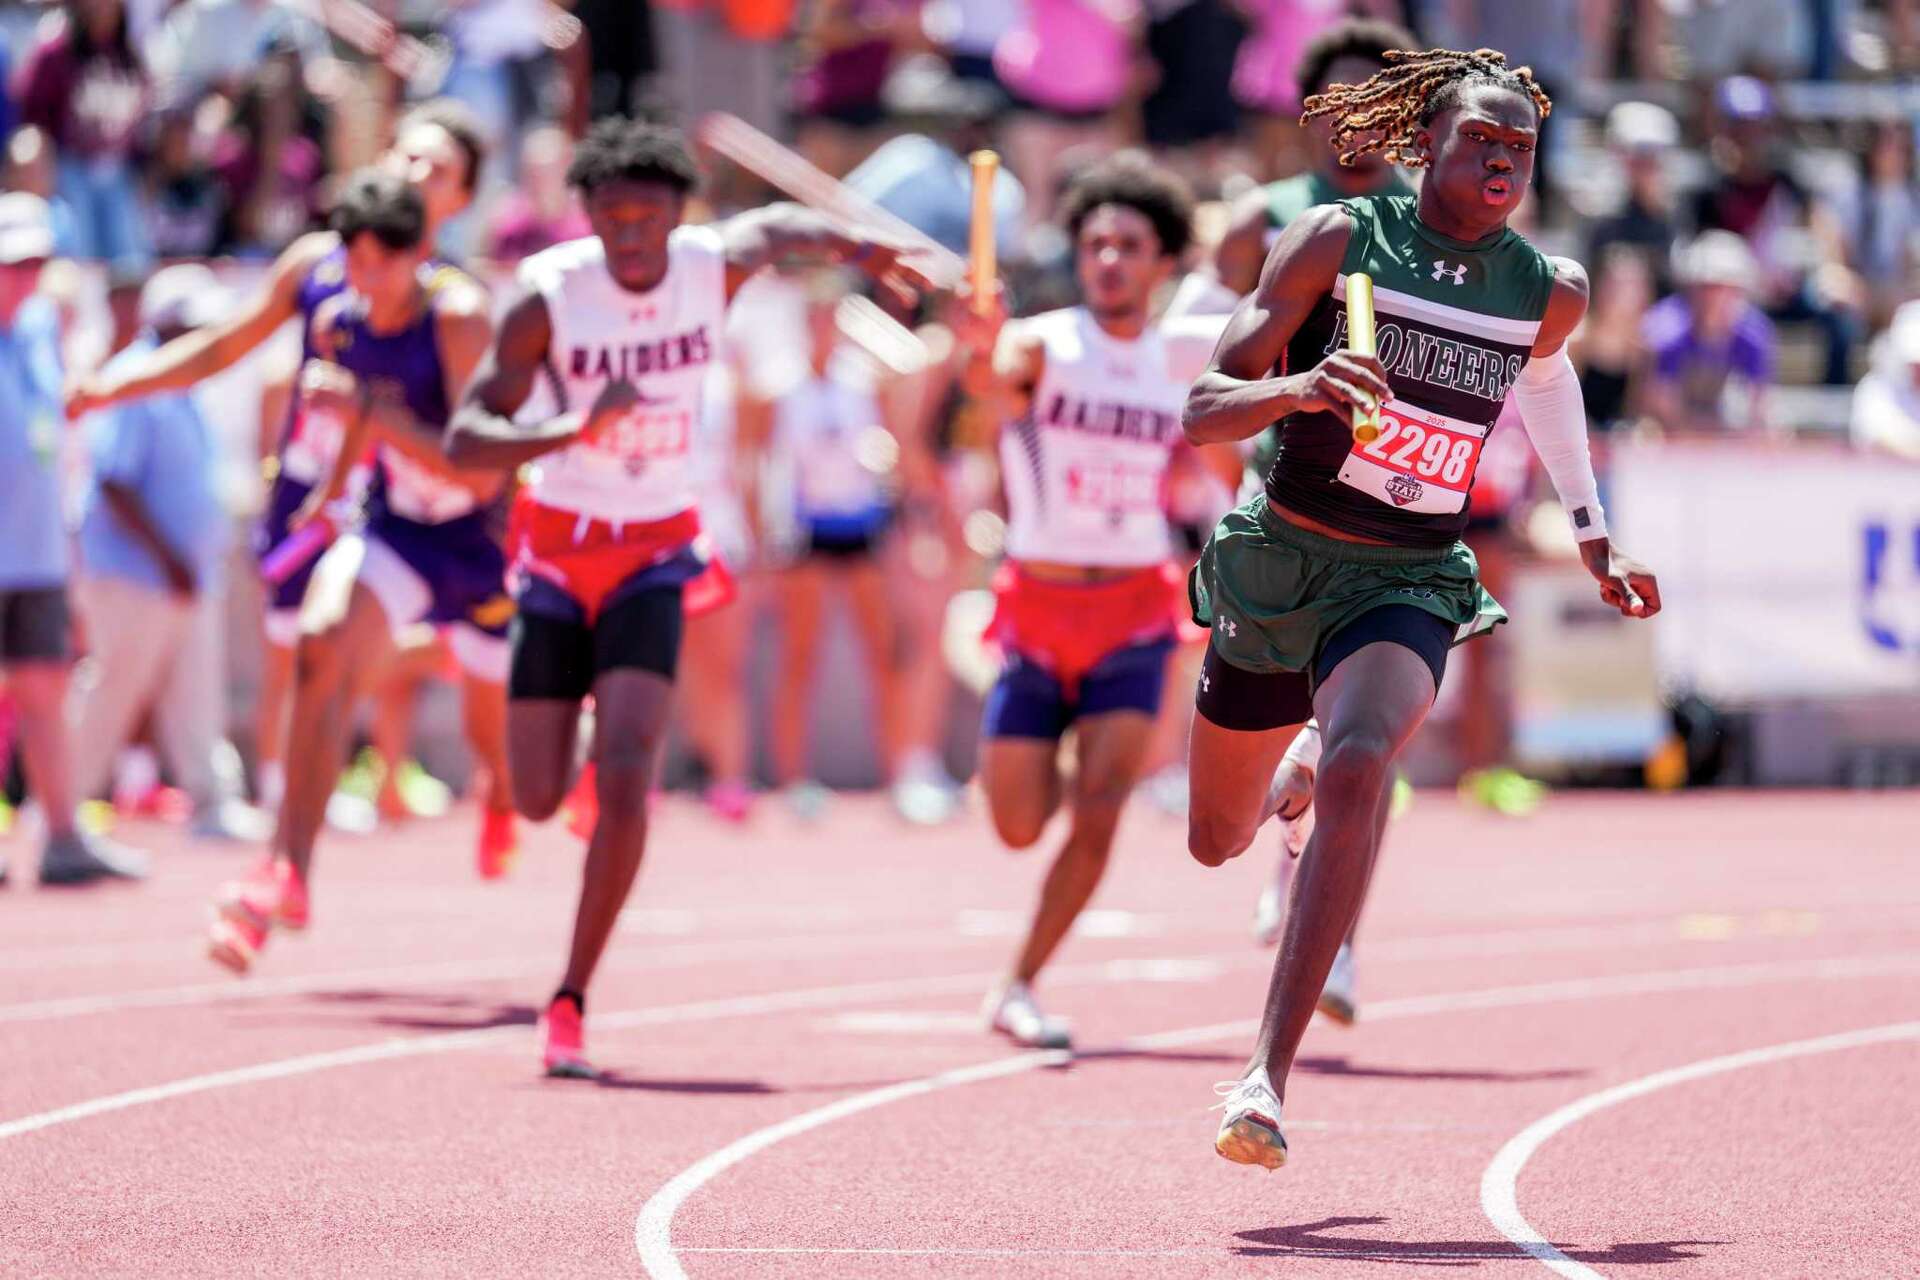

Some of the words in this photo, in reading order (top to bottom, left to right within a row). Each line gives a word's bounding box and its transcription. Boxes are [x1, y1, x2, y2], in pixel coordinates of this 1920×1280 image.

[1323, 310, 1522, 402] PONEERS
[1425, 415, 1447, 427] 2025
[1363, 415, 1473, 484] 2298
[1386, 481, 1423, 499] STATE
